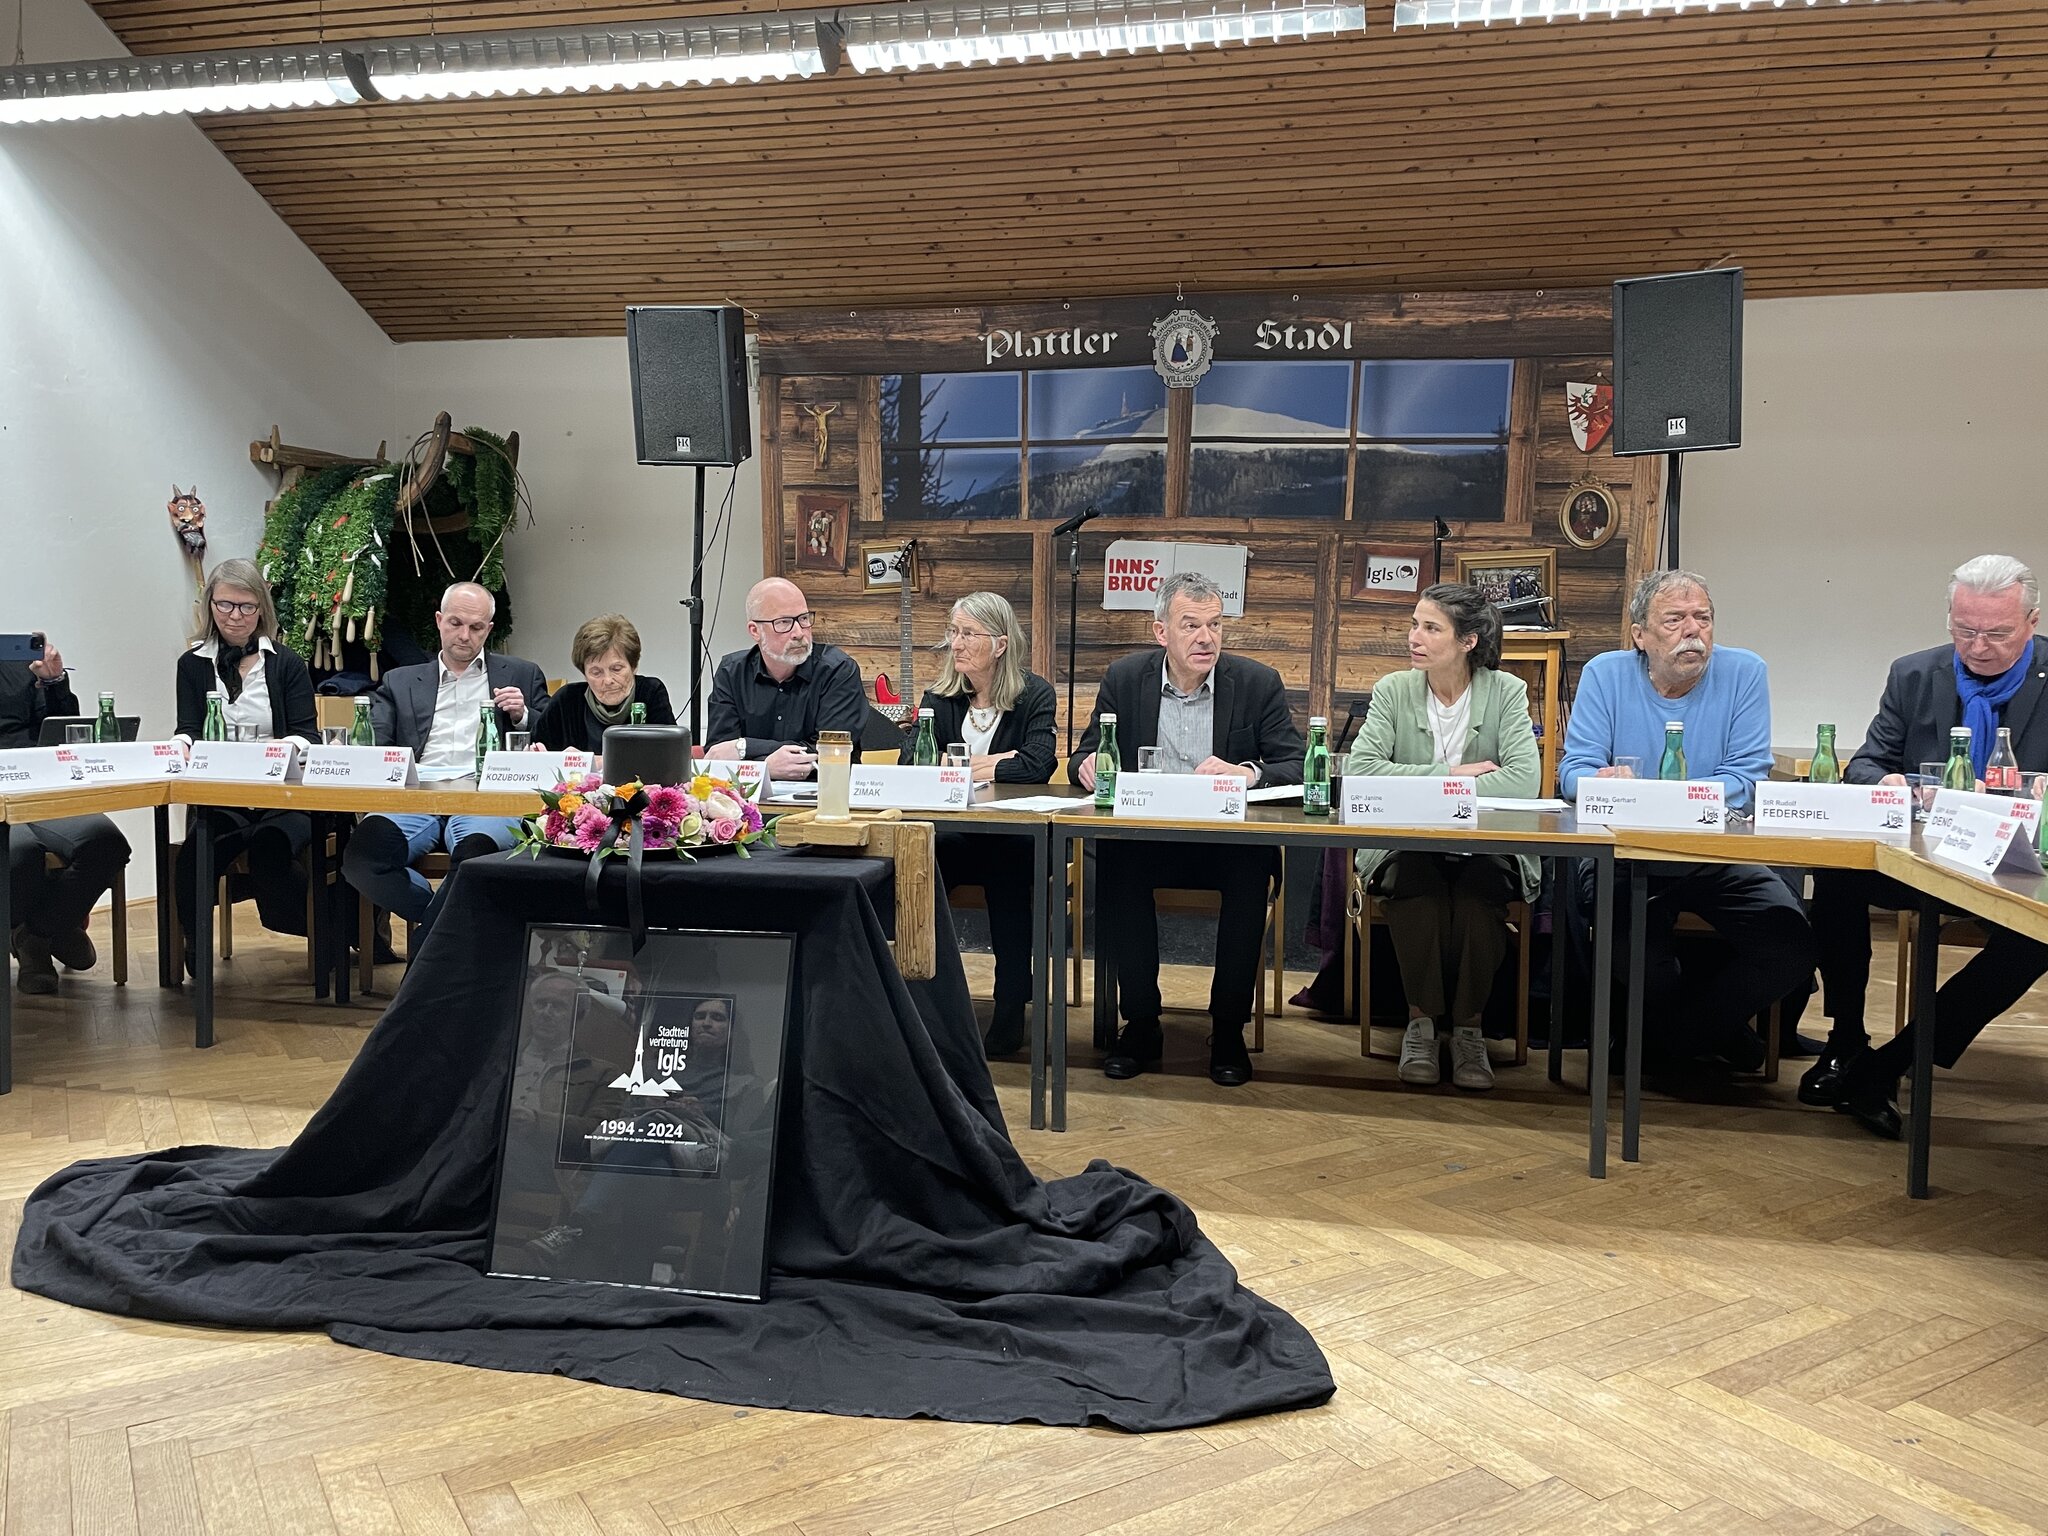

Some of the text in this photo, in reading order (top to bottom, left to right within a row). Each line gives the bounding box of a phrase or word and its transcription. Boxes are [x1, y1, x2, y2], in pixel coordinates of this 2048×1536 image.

[978, 319, 1352, 365] Plattler Stadl
[1166, 375, 1200, 383] VILL-IGLS
[1367, 566, 1394, 584] Igls
[1107, 575, 1164, 592] BRUC
[1217, 589, 1238, 600] tadt
[309, 767, 351, 776] HOFBAUER
[486, 773, 540, 782] KOZUBOWSKI
[853, 787, 881, 796] ZIMAK
[1687, 793, 1719, 801] BRUCK
[1121, 797, 1146, 807] WILLI
[1871, 797, 1904, 805] BRUCK
[1351, 803, 1371, 813] BEX
[1585, 804, 1614, 815] FRITZ
[1762, 808, 1830, 820] FEDERSPIEL
[657, 1025, 690, 1038] Stadtteil
[649, 1037, 688, 1051] vertretung
[657, 1048, 687, 1077] Igls
[600, 1119, 635, 1135] 1994
[646, 1122, 683, 1138] 2024
